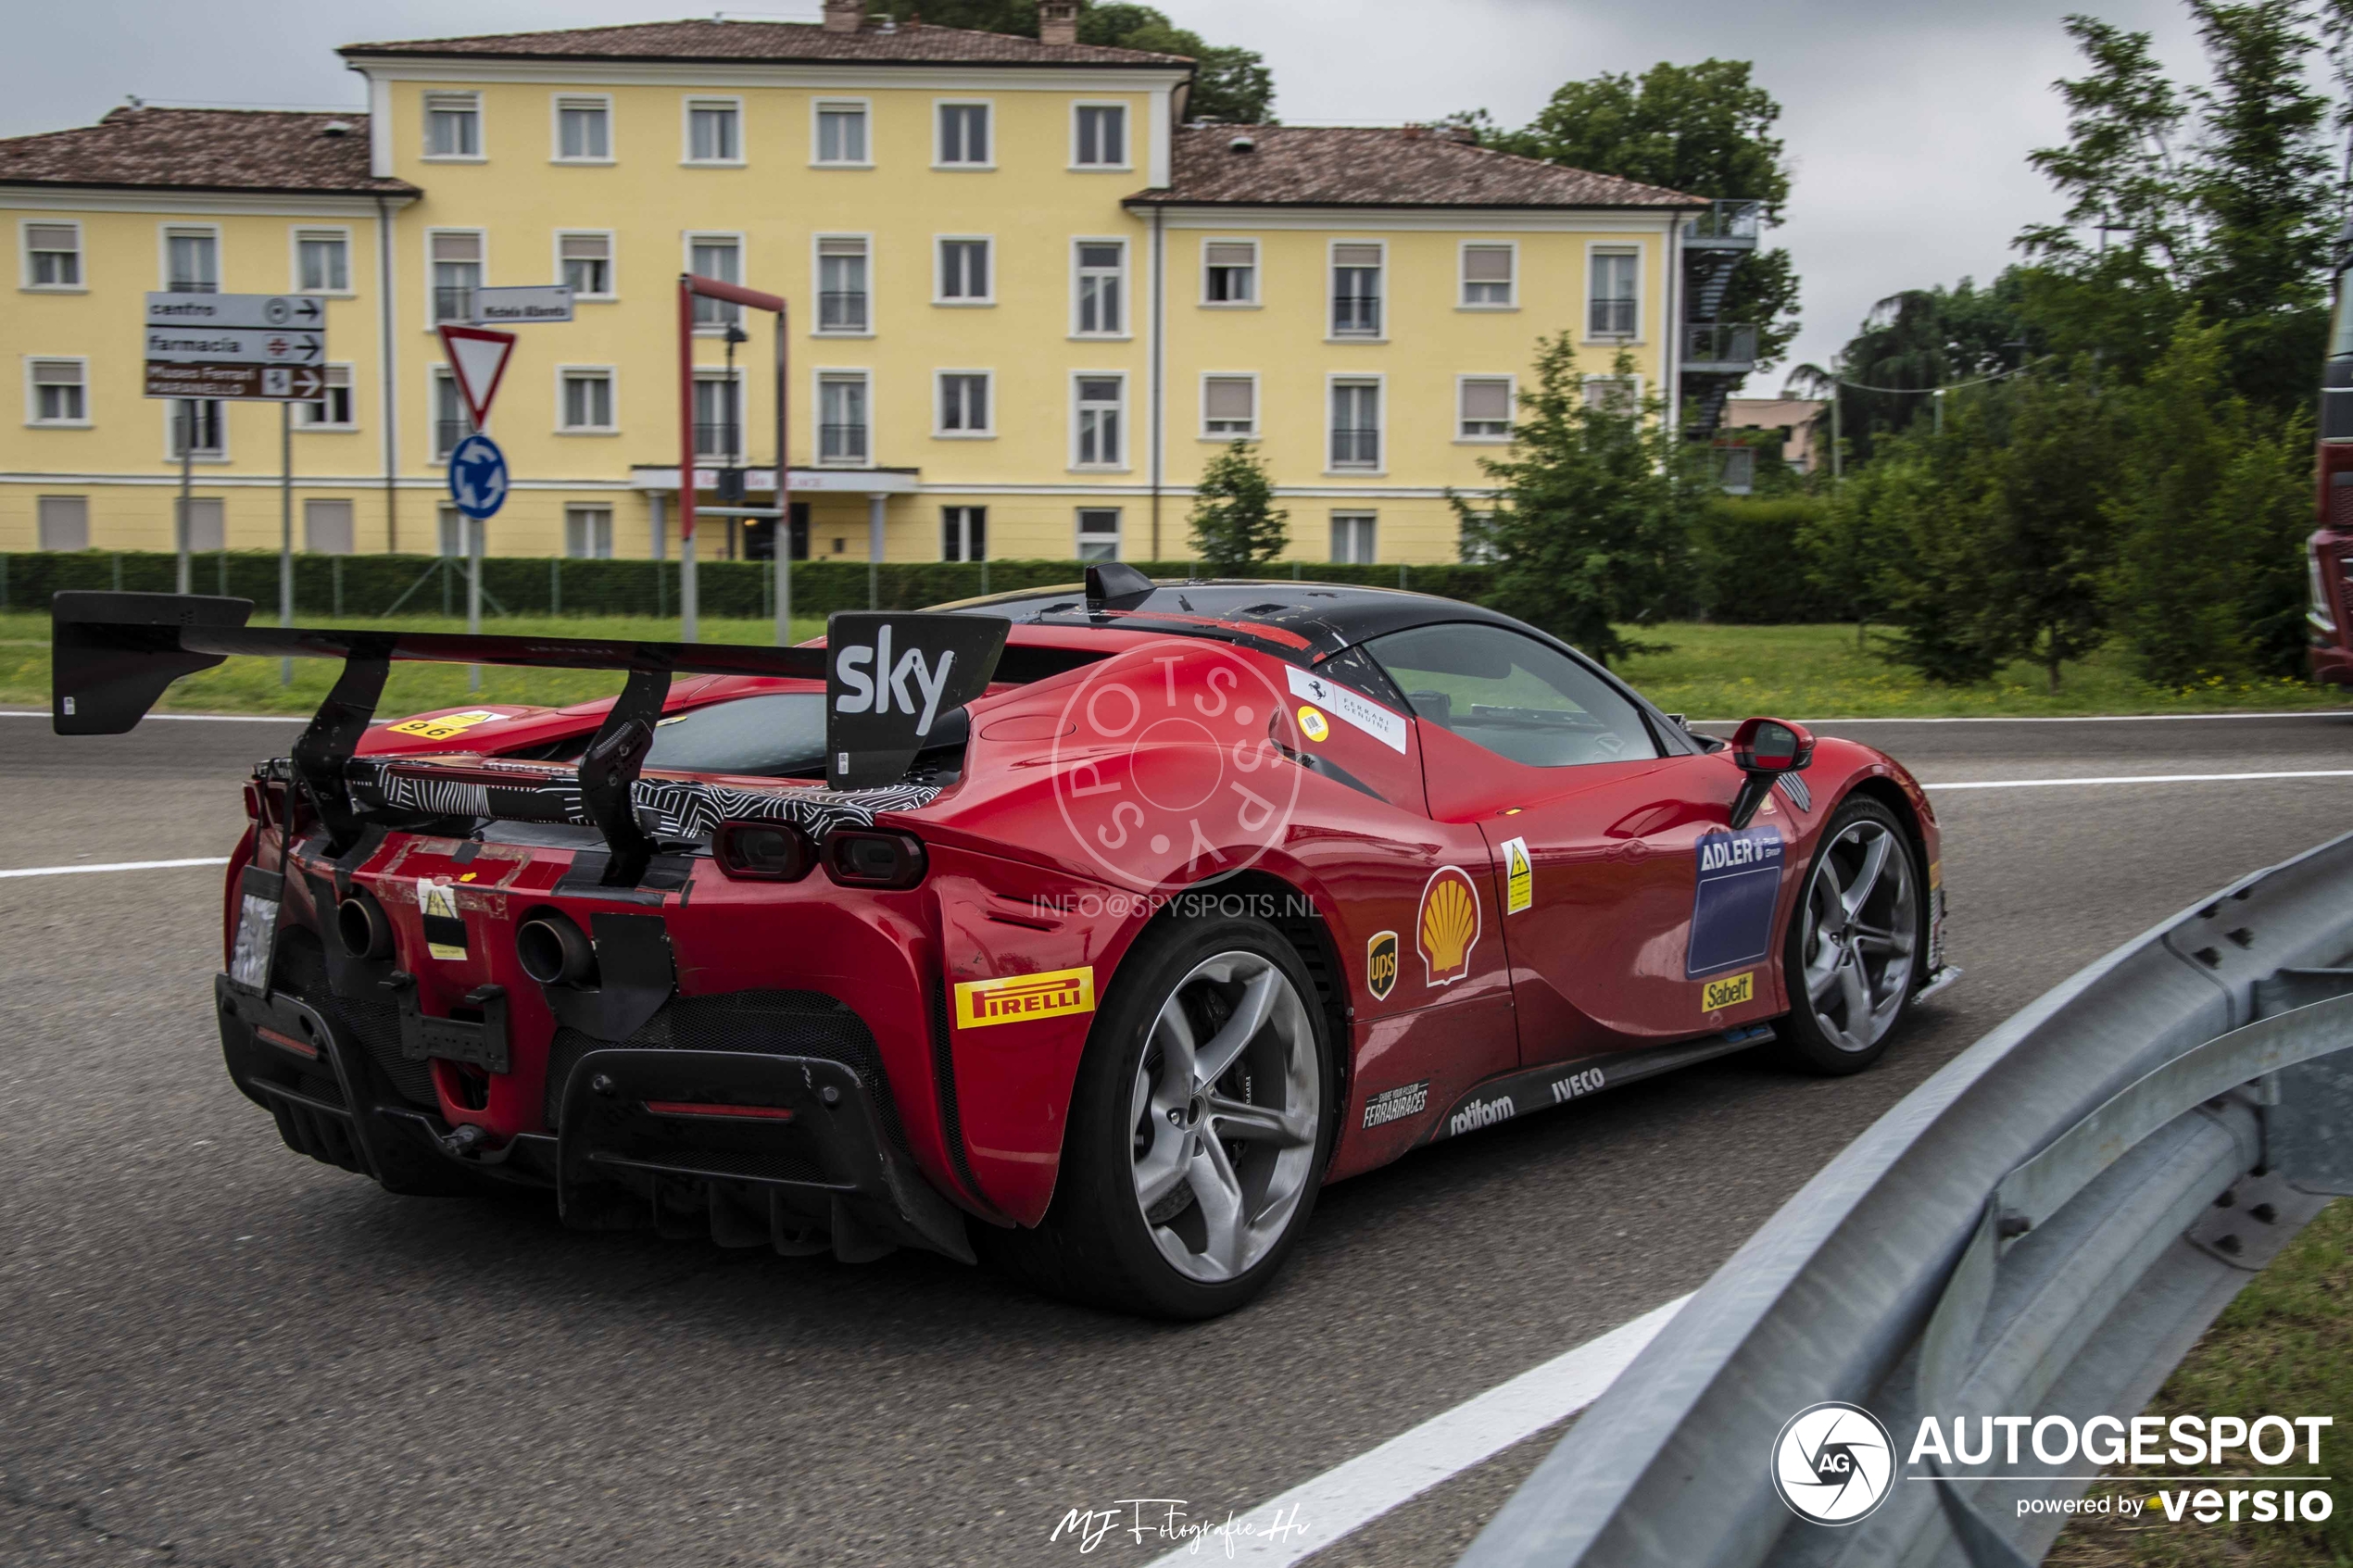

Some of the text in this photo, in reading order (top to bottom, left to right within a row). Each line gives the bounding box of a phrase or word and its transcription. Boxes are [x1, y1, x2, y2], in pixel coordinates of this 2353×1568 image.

[150, 302, 217, 316] centro
[149, 335, 243, 352] farmacia
[836, 624, 955, 736] sky
[1343, 697, 1389, 725] FERRARI
[1344, 705, 1389, 733] GENUINE
[1701, 838, 1753, 871] ADLER
[1371, 952, 1394, 988] ups
[971, 977, 1081, 1019] PIRELLI
[1707, 977, 1748, 1008] Sabelt
[1552, 1067, 1604, 1103] IVECO
[1362, 1089, 1428, 1129] FERRARIRACES
[1451, 1096, 1516, 1136] rotiform
